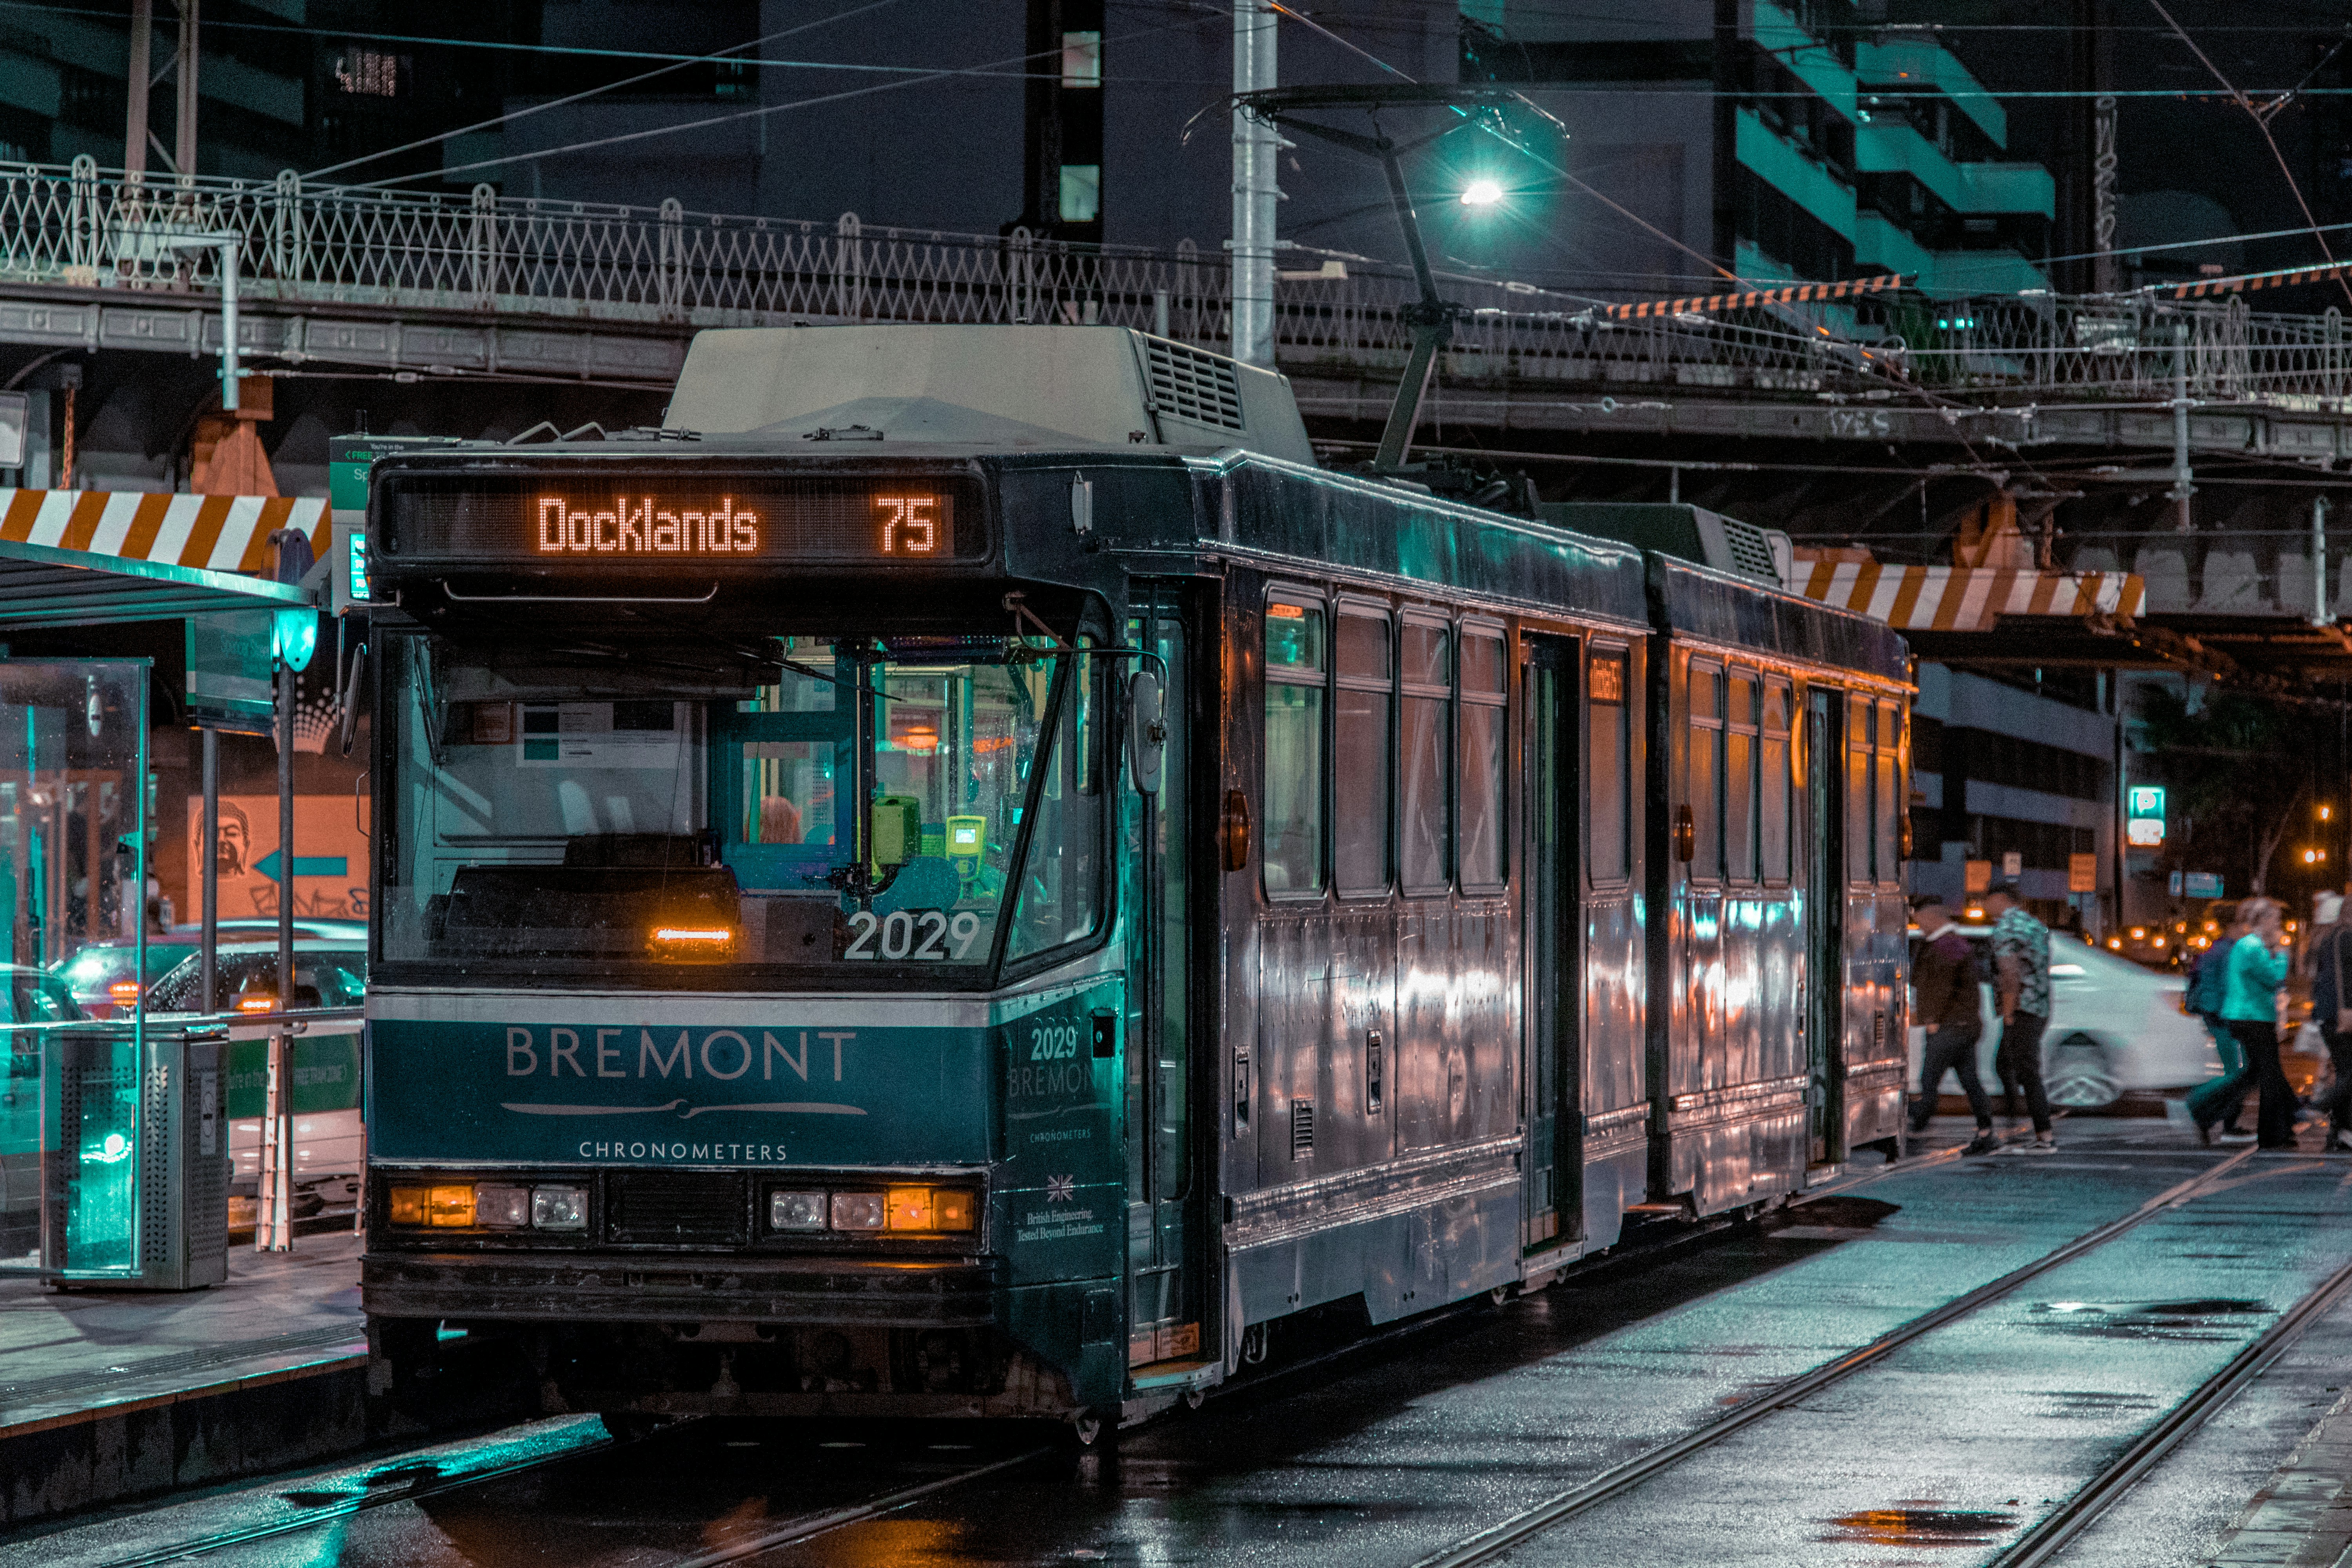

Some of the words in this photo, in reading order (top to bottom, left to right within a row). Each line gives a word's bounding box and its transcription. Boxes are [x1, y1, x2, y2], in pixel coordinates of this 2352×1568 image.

[539, 498, 757, 551] Docklands
[878, 498, 933, 551] 75
[844, 911, 980, 960] 2029
[506, 1027, 857, 1082] BREMONT
[1031, 1025, 1076, 1061] 2029
[1030, 1129, 1091, 1143] CHRONOMETERS
[579, 1141, 787, 1161] CHRONOMETERS
[1027, 1211, 1050, 1225] British
[1017, 1227, 1039, 1242] Tested
[1040, 1225, 1065, 1241] Beyond
[1067, 1223, 1103, 1236] Endurance
